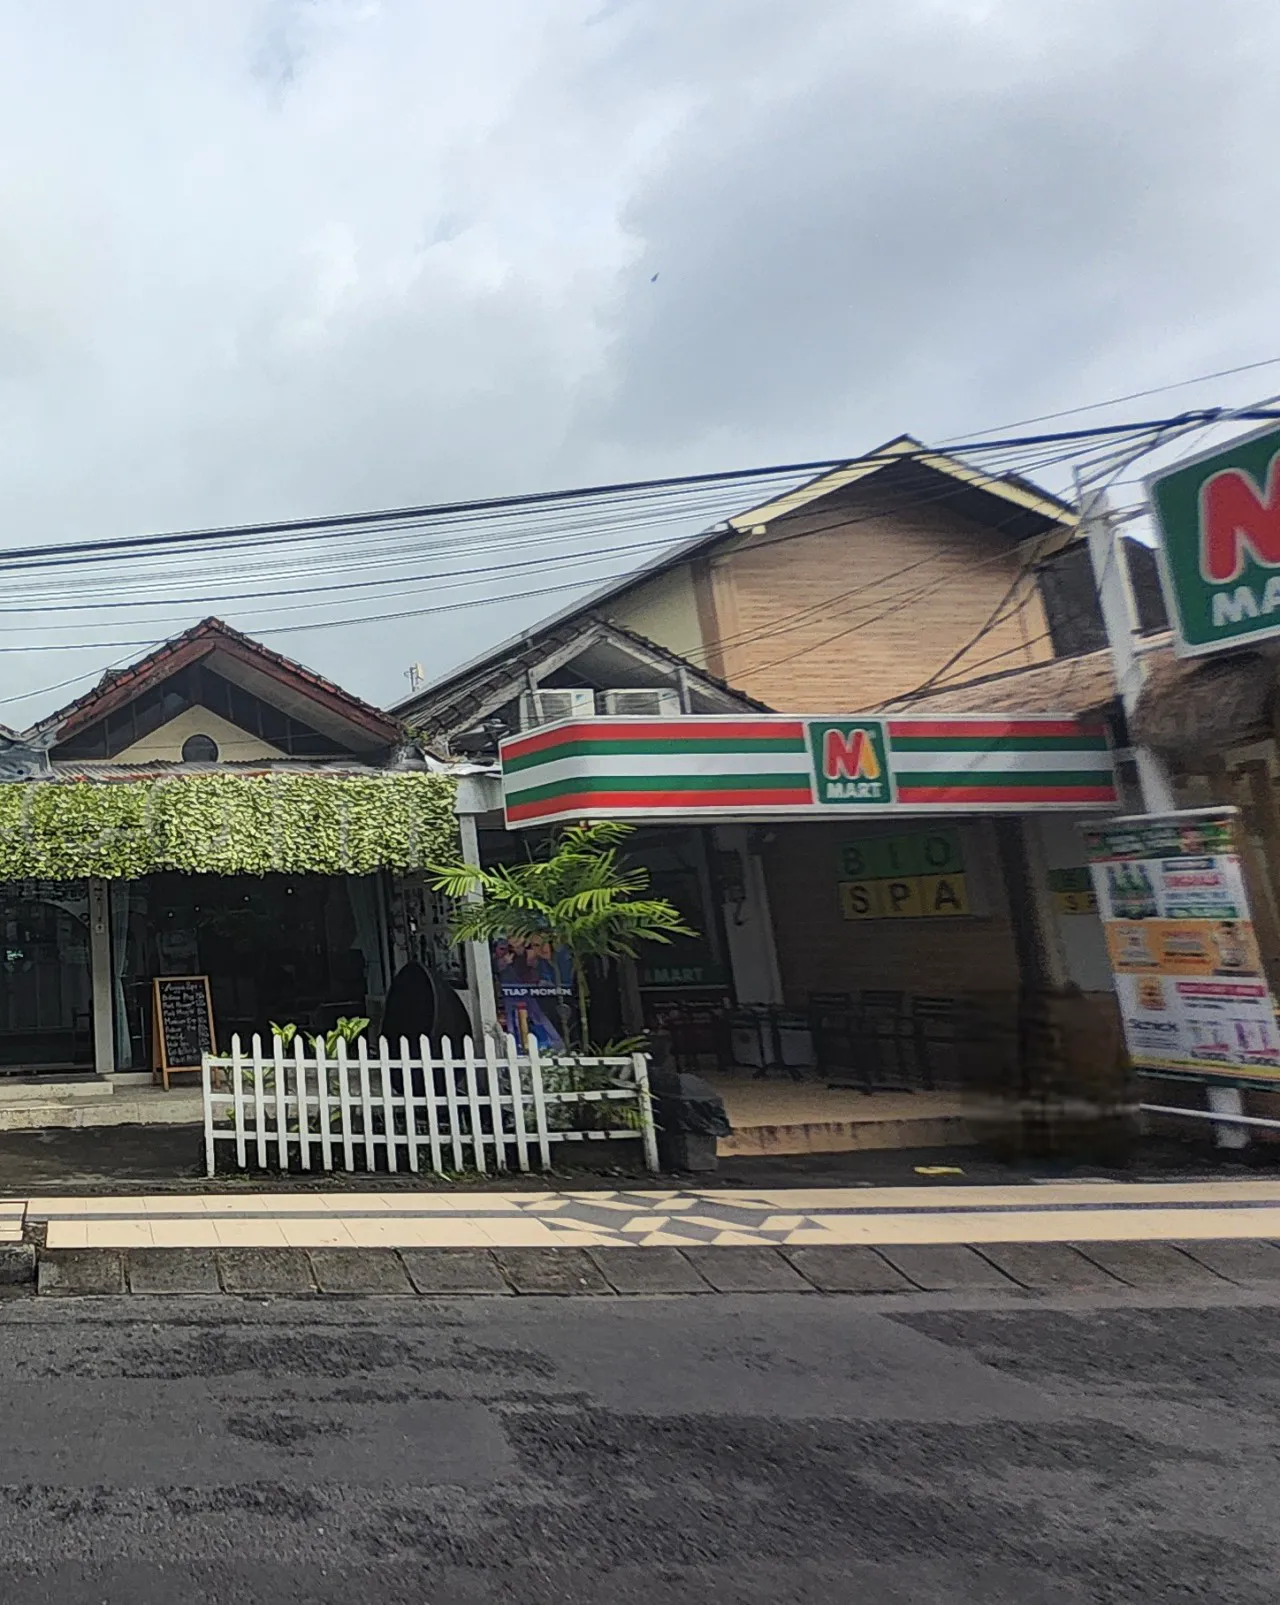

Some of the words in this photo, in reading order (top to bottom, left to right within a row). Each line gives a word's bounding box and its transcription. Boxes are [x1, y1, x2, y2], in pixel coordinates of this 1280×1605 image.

[826, 783, 883, 798] MART
[841, 837, 953, 876] BIO
[850, 880, 963, 914] SPA
[502, 988, 528, 996] TIAP
